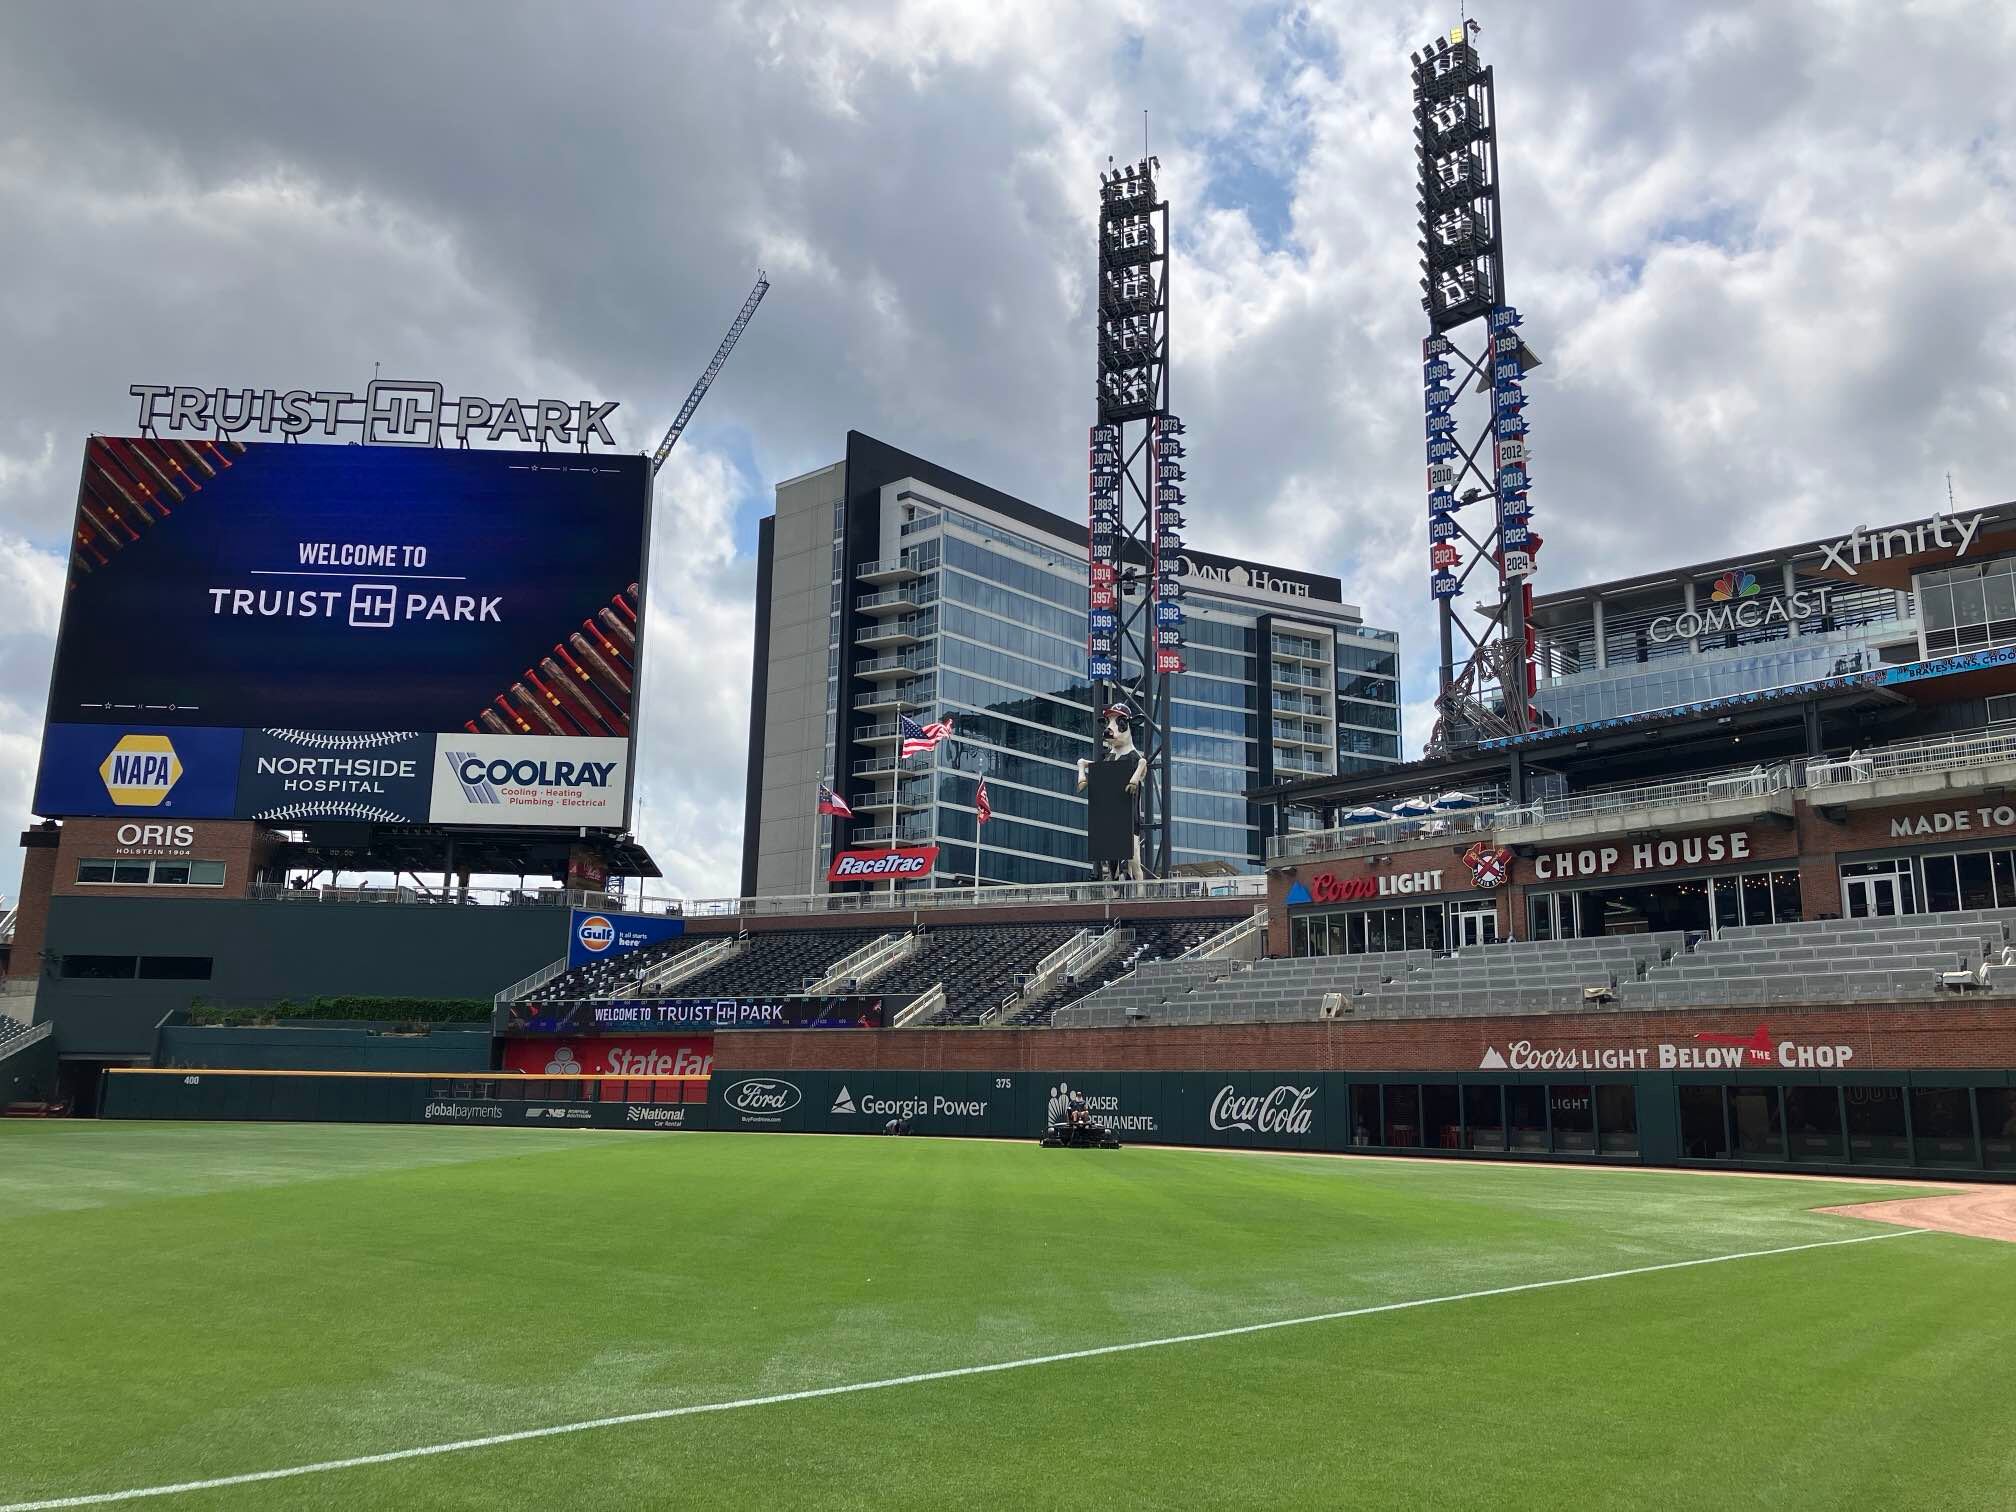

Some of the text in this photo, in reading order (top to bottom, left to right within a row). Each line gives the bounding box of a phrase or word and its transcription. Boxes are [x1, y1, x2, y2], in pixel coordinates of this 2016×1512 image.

[1495, 311, 1514, 326] 1997
[1427, 339, 1447, 354] 1996
[1496, 336, 1516, 352] 1999
[1428, 364, 1448, 379] 1998
[1498, 364, 1518, 379] 2001
[1429, 390, 1449, 405] 2000
[1499, 390, 1520, 406] 2003
[130, 384, 620, 446] TRUIST PARK
[1160, 420, 1177, 430] 1873
[1430, 416, 1450, 431] 2002
[1500, 417, 1522, 433] 2005
[1095, 431, 1112, 441] 1872
[1160, 443, 1178, 454] 1875
[1432, 441, 1452, 457] 2004
[1502, 445, 1522, 460] 2012
[1095, 453, 1112, 464] 1874
[1160, 466, 1178, 477] 1878
[1432, 469, 1451, 482] 2010
[1094, 476, 1112, 487] 1877
[1503, 472, 1523, 488] 2018
[1160, 490, 1178, 500] 1891
[1433, 495, 1452, 510] 2013
[1504, 500, 1525, 515] 2020
[1160, 513, 1178, 524] 1893
[1094, 523, 1112, 533] 1892
[1434, 522, 1453, 537] 2019
[1506, 528, 1526, 543] 2022
[1160, 537, 1179, 548] 1898
[1820, 512, 1983, 575] xfinity
[299, 543, 427, 568] WELCOME TO
[1094, 546, 1111, 556] 1897
[1435, 549, 1454, 563] 2021
[1160, 560, 1178, 572] 1948
[1507, 556, 1528, 570] 2024
[1093, 569, 1110, 580] 1914
[1160, 584, 1178, 595] 1958
[1250, 569, 1310, 598] HOTEL
[1436, 578, 1456, 592] 2023
[208, 588, 503, 622] TRUIST PARK
[1093, 592, 1110, 603] 1957
[1160, 608, 1178, 619] 1982
[1650, 586, 1832, 642] COMCAST
[1093, 616, 1111, 627] 1969
[1093, 639, 1110, 651] 1991
[1160, 632, 1179, 644] 1992
[1092, 663, 1111, 674] 1993
[1160, 657, 1179, 668] 1995
[1910, 662, 1947, 677] BRAVES
[113, 756, 168, 785] NAPA
[257, 758, 416, 777] NORTHSIDE
[460, 759, 617, 787] COOLRAY
[284, 779, 384, 793] HOSPITAL
[501, 788, 582, 798] Cooling Heating
[510, 798, 606, 807] Plumbing Electrical
[1891, 806, 2015, 837] MADE TO
[118, 824, 193, 846] ORIS
[1536, 848, 1618, 879] CHOP
[1633, 832, 1750, 870] HOUSE
[837, 854, 924, 874] RaceTrac
[1311, 872, 1378, 903] Coors
[1379, 870, 1443, 896] LIGHT
[581, 928, 614, 939] Gulf
[595, 1005, 782, 1021] WELCOME TO TRUIST PARK
[605, 1048, 672, 1075] State
[1509, 1041, 1852, 1069] Coors LIGHT BELOW THE CHOP
[184, 1076, 200, 1084] 400
[996, 1079, 1011, 1088] 375
[737, 1083, 787, 1108] Ford
[862, 1095, 987, 1119] Georgia Power
[1086, 1097, 1118, 1110] KAISER
[1210, 1084, 1319, 1133] Coca-Cola
[1552, 1099, 1588, 1109] LIGHT
[639, 1108, 684, 1120] National
